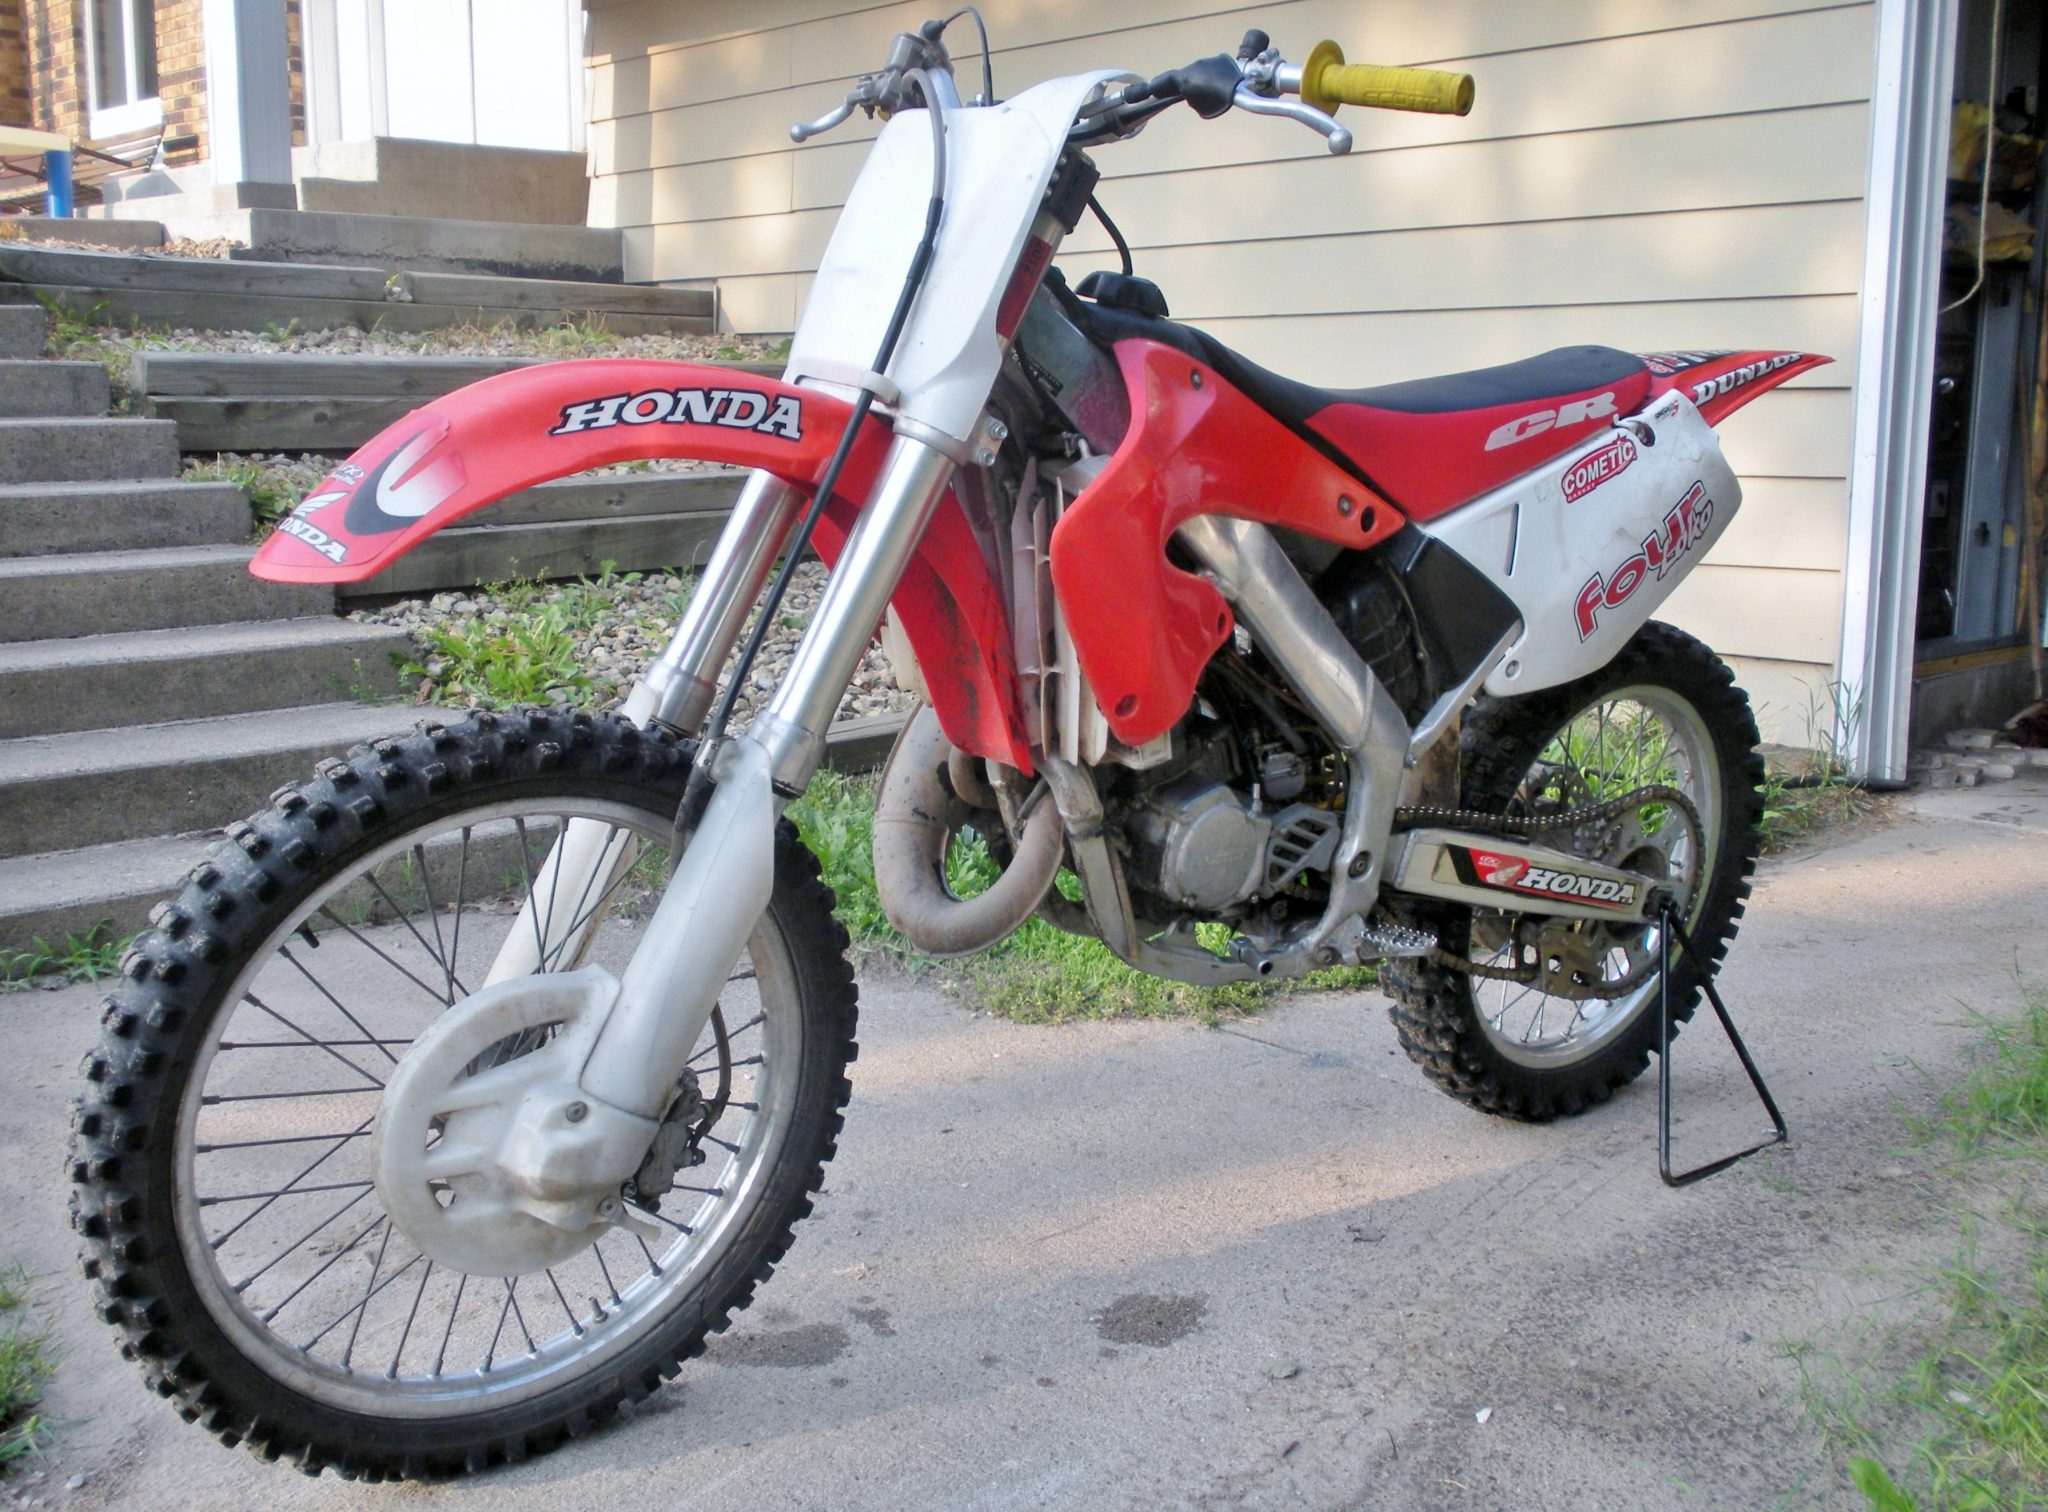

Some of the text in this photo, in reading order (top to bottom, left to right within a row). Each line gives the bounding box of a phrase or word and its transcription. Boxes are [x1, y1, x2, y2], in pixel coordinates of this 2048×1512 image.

[551, 388, 802, 440] HONDA
[1484, 391, 1618, 451] CR
[1563, 441, 1634, 495] COMETIC
[279, 517, 347, 564] ONDA
[1516, 868, 1637, 904] HONDA
